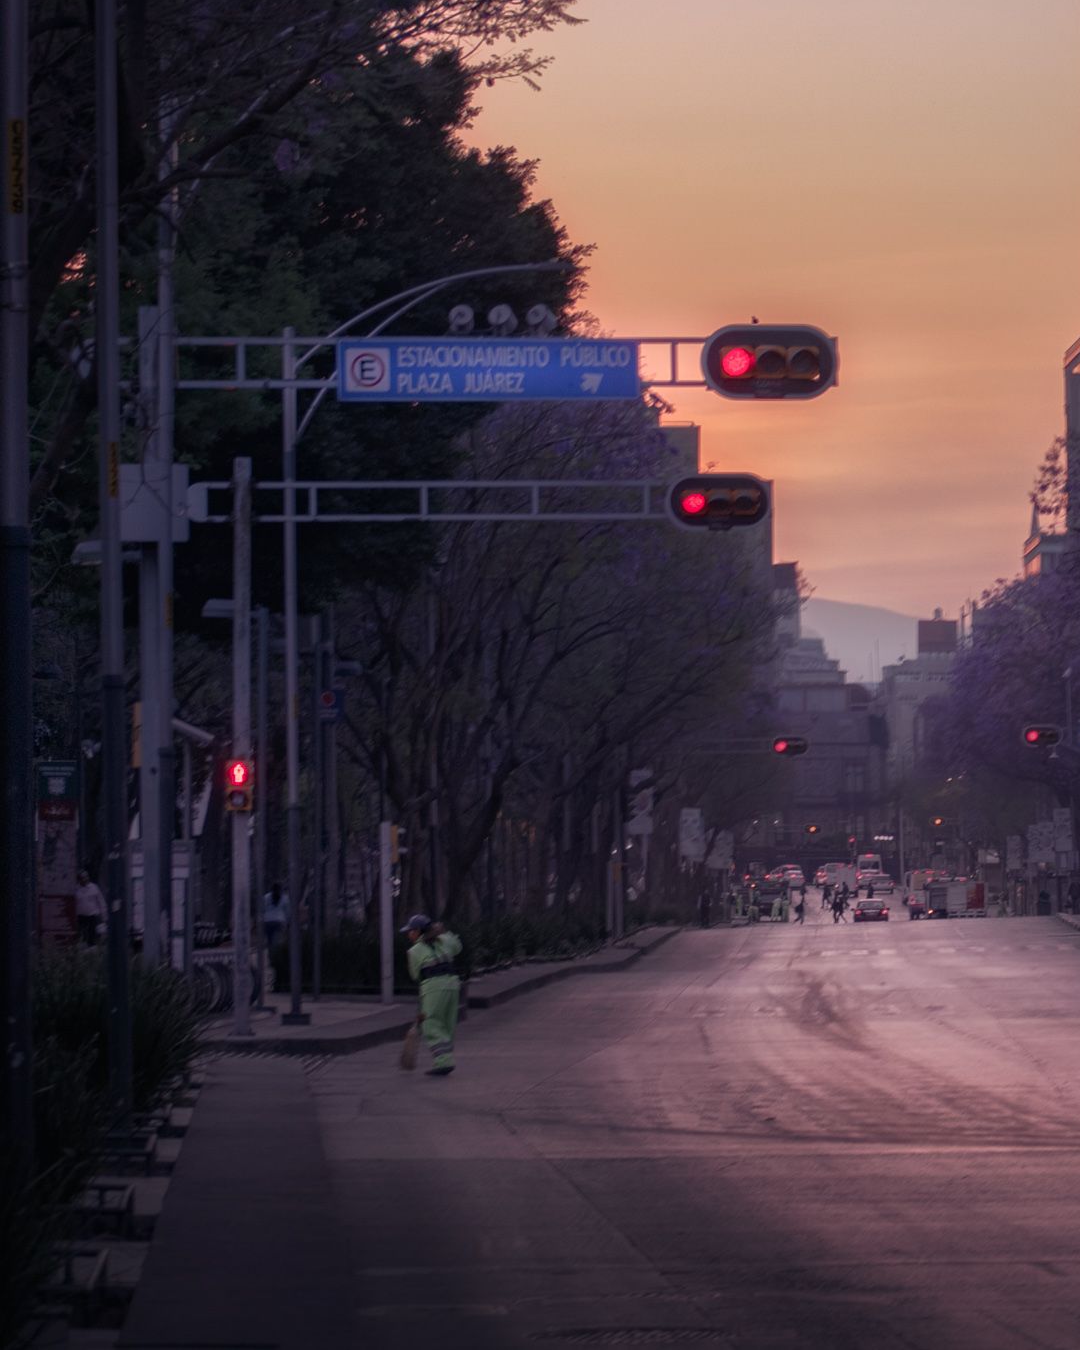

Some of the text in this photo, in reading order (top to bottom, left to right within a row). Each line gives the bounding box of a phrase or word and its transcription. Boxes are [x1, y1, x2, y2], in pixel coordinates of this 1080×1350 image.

[397, 342, 630, 367] ESTACIONAMIENTO PÚBLICO
[397, 368, 525, 394] PLAZA JUÁREZ
